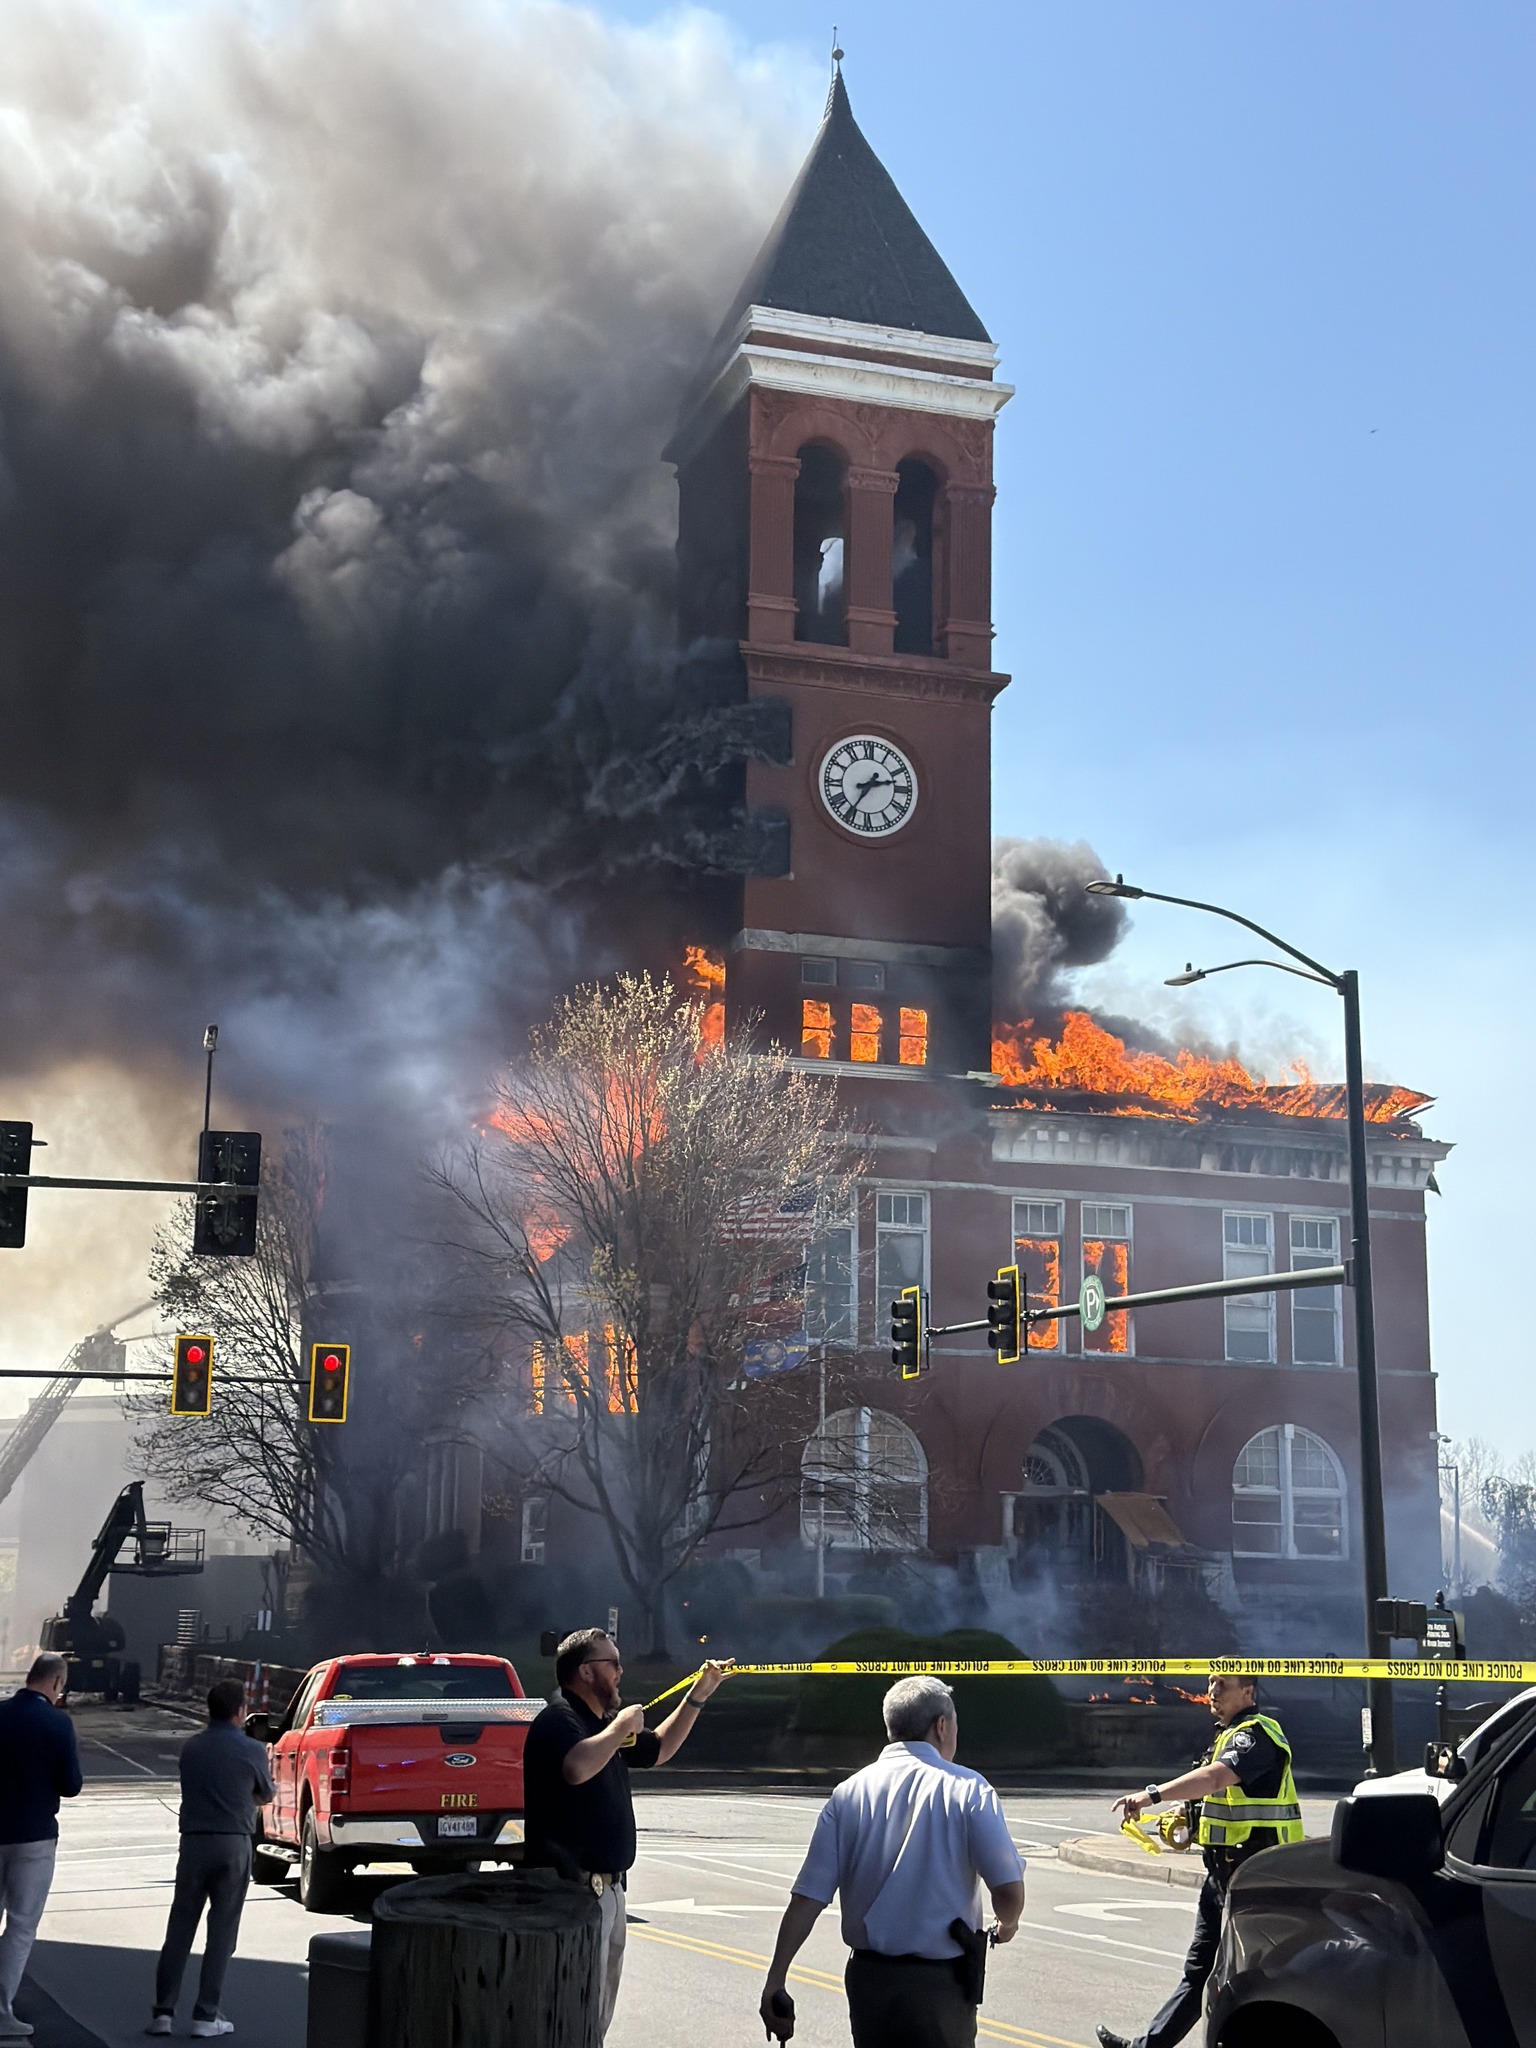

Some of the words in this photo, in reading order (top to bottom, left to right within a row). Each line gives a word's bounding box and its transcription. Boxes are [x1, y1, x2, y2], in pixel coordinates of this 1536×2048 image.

[1086, 1288, 1096, 1318] P
[856, 1662, 888, 1672] CROSS
[891, 1662, 910, 1672] NOT
[914, 1662, 927, 1671] DO
[930, 1661, 952, 1671] LINE
[955, 1661, 990, 1671] POLICE
[1032, 1660, 1064, 1672] CROSS
[1068, 1660, 1086, 1672] NOT
[1090, 1660, 1104, 1672] DO
[1107, 1660, 1128, 1672] LINE
[1132, 1660, 1166, 1672] POLICE
[1209, 1660, 1242, 1672] CROSS
[1245, 1660, 1264, 1673] NOT
[1268, 1660, 1281, 1673] DO
[1284, 1660, 1306, 1674] LINE
[1308, 1660, 1344, 1674] POLICE
[1387, 1662, 1420, 1676] CROSS
[1422, 1662, 1442, 1676] NOT
[1446, 1662, 1459, 1677] DO
[1462, 1663, 1484, 1678] LINE
[1487, 1664, 1522, 1678] POLICE
[441, 1794, 478, 1808] FIRE
